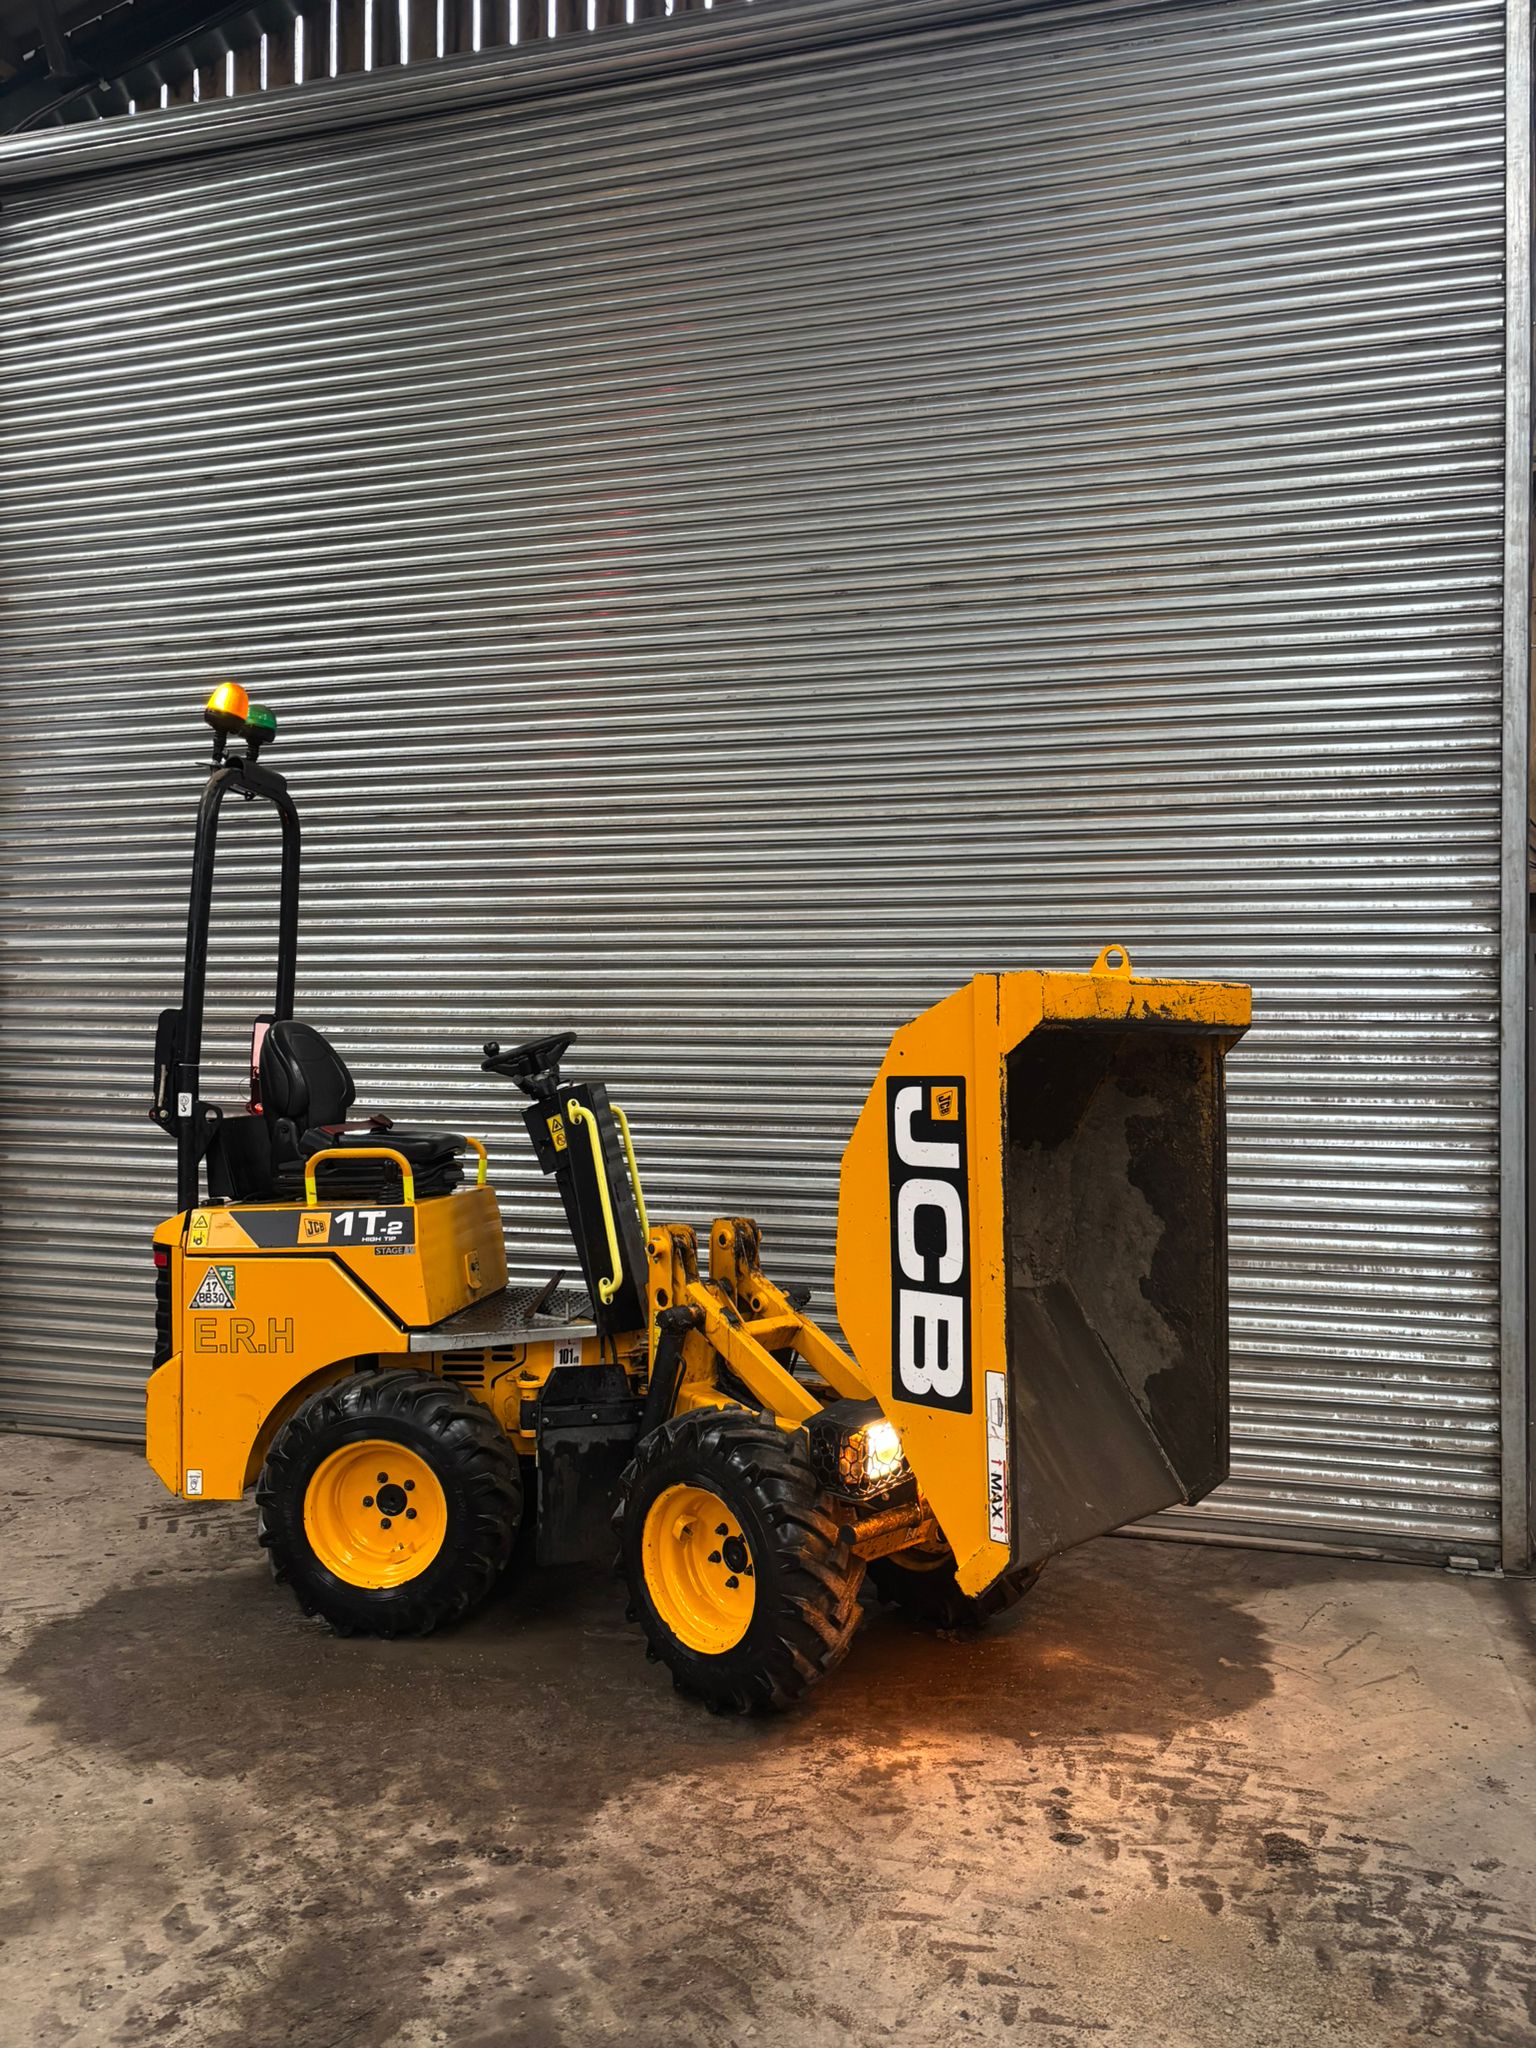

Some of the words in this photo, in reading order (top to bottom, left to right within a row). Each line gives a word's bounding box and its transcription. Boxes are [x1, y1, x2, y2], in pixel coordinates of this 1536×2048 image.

[306, 1221, 326, 1235] JCB
[894, 1086, 964, 1398] JCB
[375, 1247, 403, 1255] STAGE
[206, 1281, 218, 1292] 17
[194, 1317, 295, 1354] E.R.H
[558, 1348, 574, 1365] 101
[991, 1473, 1004, 1519] MAX
